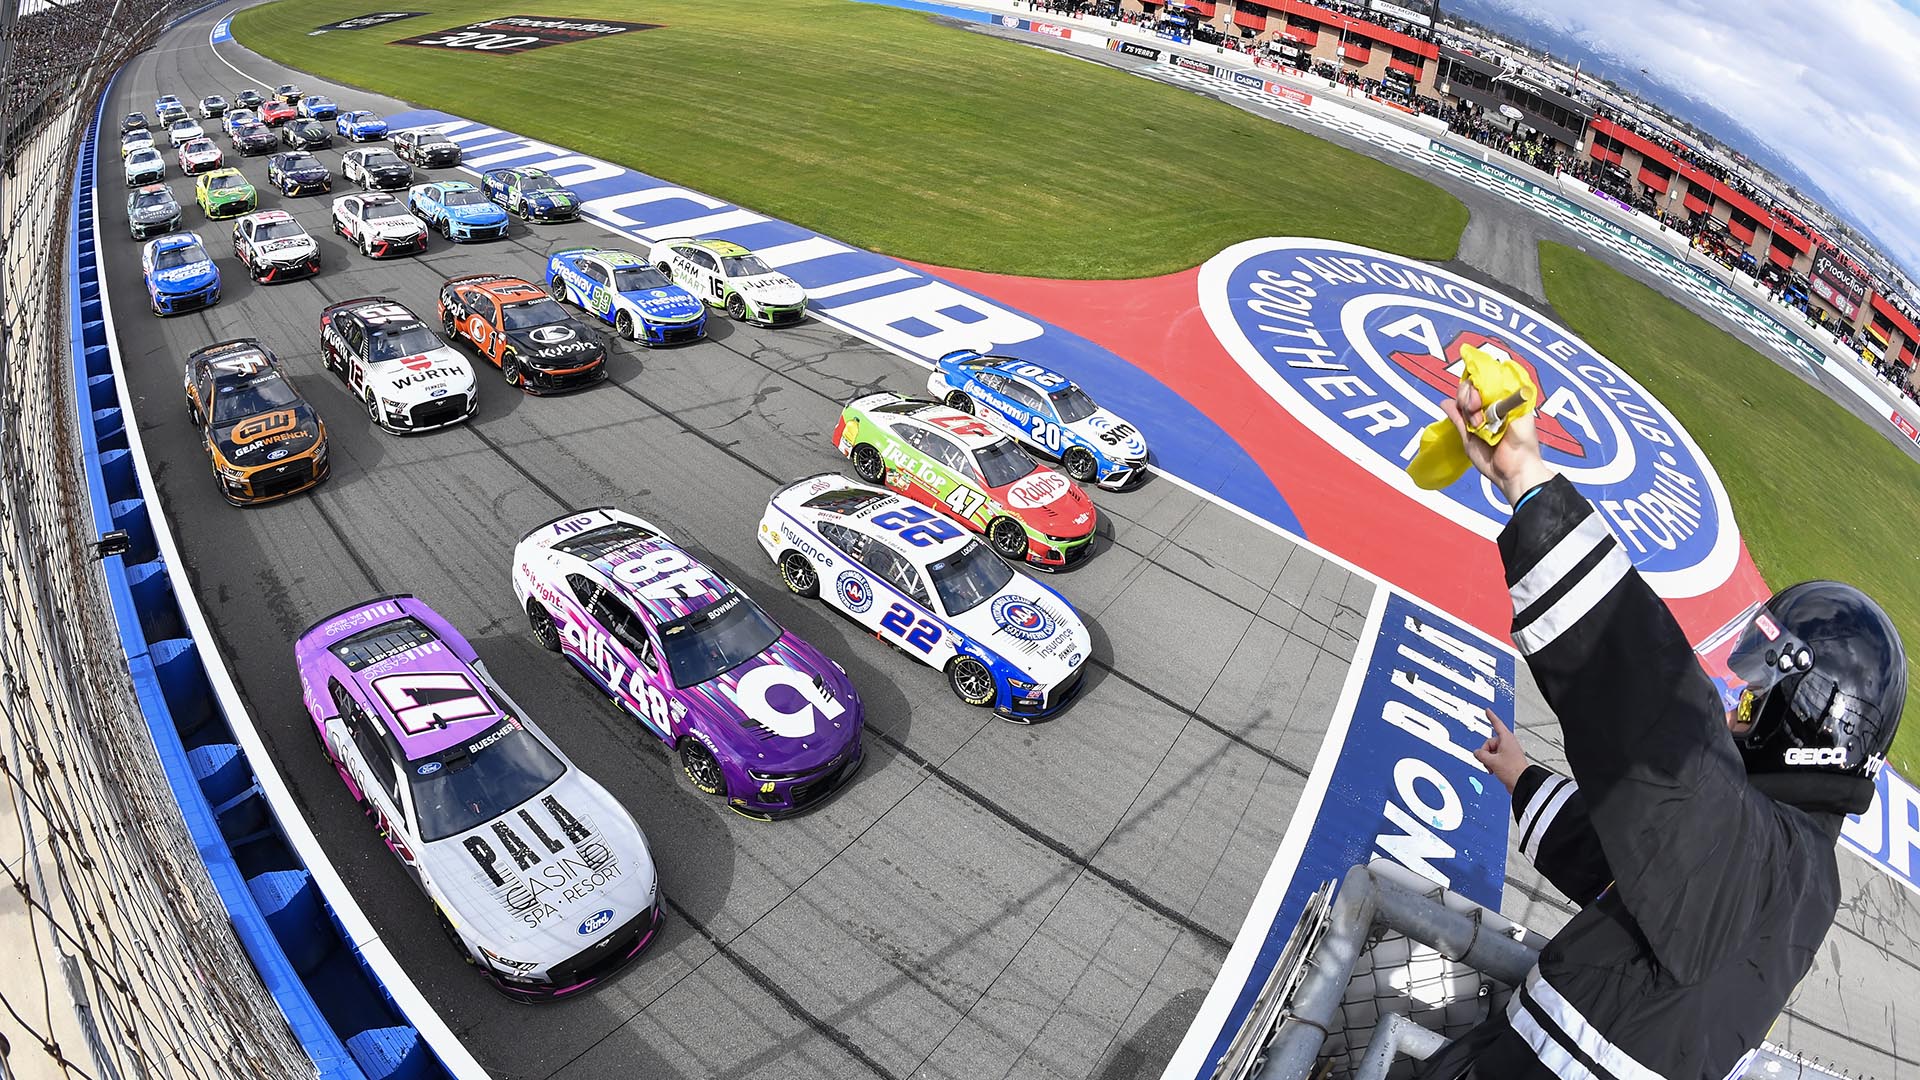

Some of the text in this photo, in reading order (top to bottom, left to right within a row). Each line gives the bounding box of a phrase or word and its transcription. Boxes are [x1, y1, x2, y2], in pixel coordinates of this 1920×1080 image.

[418, 31, 540, 50] 300
[1125, 45, 1154, 58] 75 YEARS
[1181, 57, 1210, 70] Production
[1237, 75, 1261, 88] CASINO
[1440, 147, 1456, 157] Ruoff
[1480, 164, 1524, 187] VICTORY LANE
[1540, 189, 1556, 201] Ruoff
[1580, 210, 1622, 235] VICTORY LANE
[1637, 240, 1652, 251] Ruoff
[557, 260, 592, 295] Freeway
[673, 256, 699, 278] FARM
[1672, 260, 1711, 286] VICTORY LANE
[1825, 260, 1864, 296] Production
[673, 268, 706, 294] SMART
[709, 275, 724, 299] 16
[592, 287, 612, 314] 99
[638, 293, 693, 308] Freeway
[647, 301, 700, 313] INSURANCE
[1721, 289, 1736, 301] Ruoff
[1753, 310, 1787, 335] VICTORY LANE
[487, 331, 497, 358] 1
[537, 341, 597, 358] Kubota
[1301, 255, 1675, 447] AUTOMOBILE CLUB
[1801, 342, 1814, 354] Ruoff
[252, 374, 277, 385] HARVICK
[350, 358, 364, 391] 12
[1016, 365, 1065, 387] 20
[235, 430, 309, 457] GEARWRENCH
[1031, 417, 1061, 452] 20
[945, 484, 987, 520] 47
[1012, 474, 1065, 506] Ralphs
[856, 497, 900, 519] Snap-on
[553, 514, 593, 536] ally
[870, 505, 965, 548] 22
[780, 521, 834, 568] Insurance
[961, 540, 979, 557] LOGANO
[521, 562, 531, 577] do
[535, 582, 564, 610] right.
[612, 549, 716, 601] 48
[846, 582, 863, 600] AAA
[325, 602, 396, 637] PALA CASINO
[707, 597, 741, 620] BOWMAN
[1010, 606, 1035, 625] AAA
[880, 602, 942, 655] 22
[367, 641, 418, 665] BUESCHER
[1037, 628, 1074, 659] Insurance
[363, 641, 442, 680] PALA CASINO
[563, 622, 626, 693] ally
[371, 672, 493, 735] 17
[628, 667, 672, 737] 48
[468, 723, 515, 754] BUESCHER
[1369, 614, 1498, 891] NO PALA
[1784, 747, 1848, 766] GEICO
[760, 781, 776, 794] 48
[462, 794, 593, 888] PALA
[506, 842, 610, 911] CASINO
[524, 864, 623, 930] SPA RESORT
[582, 910, 611, 933] Ford
